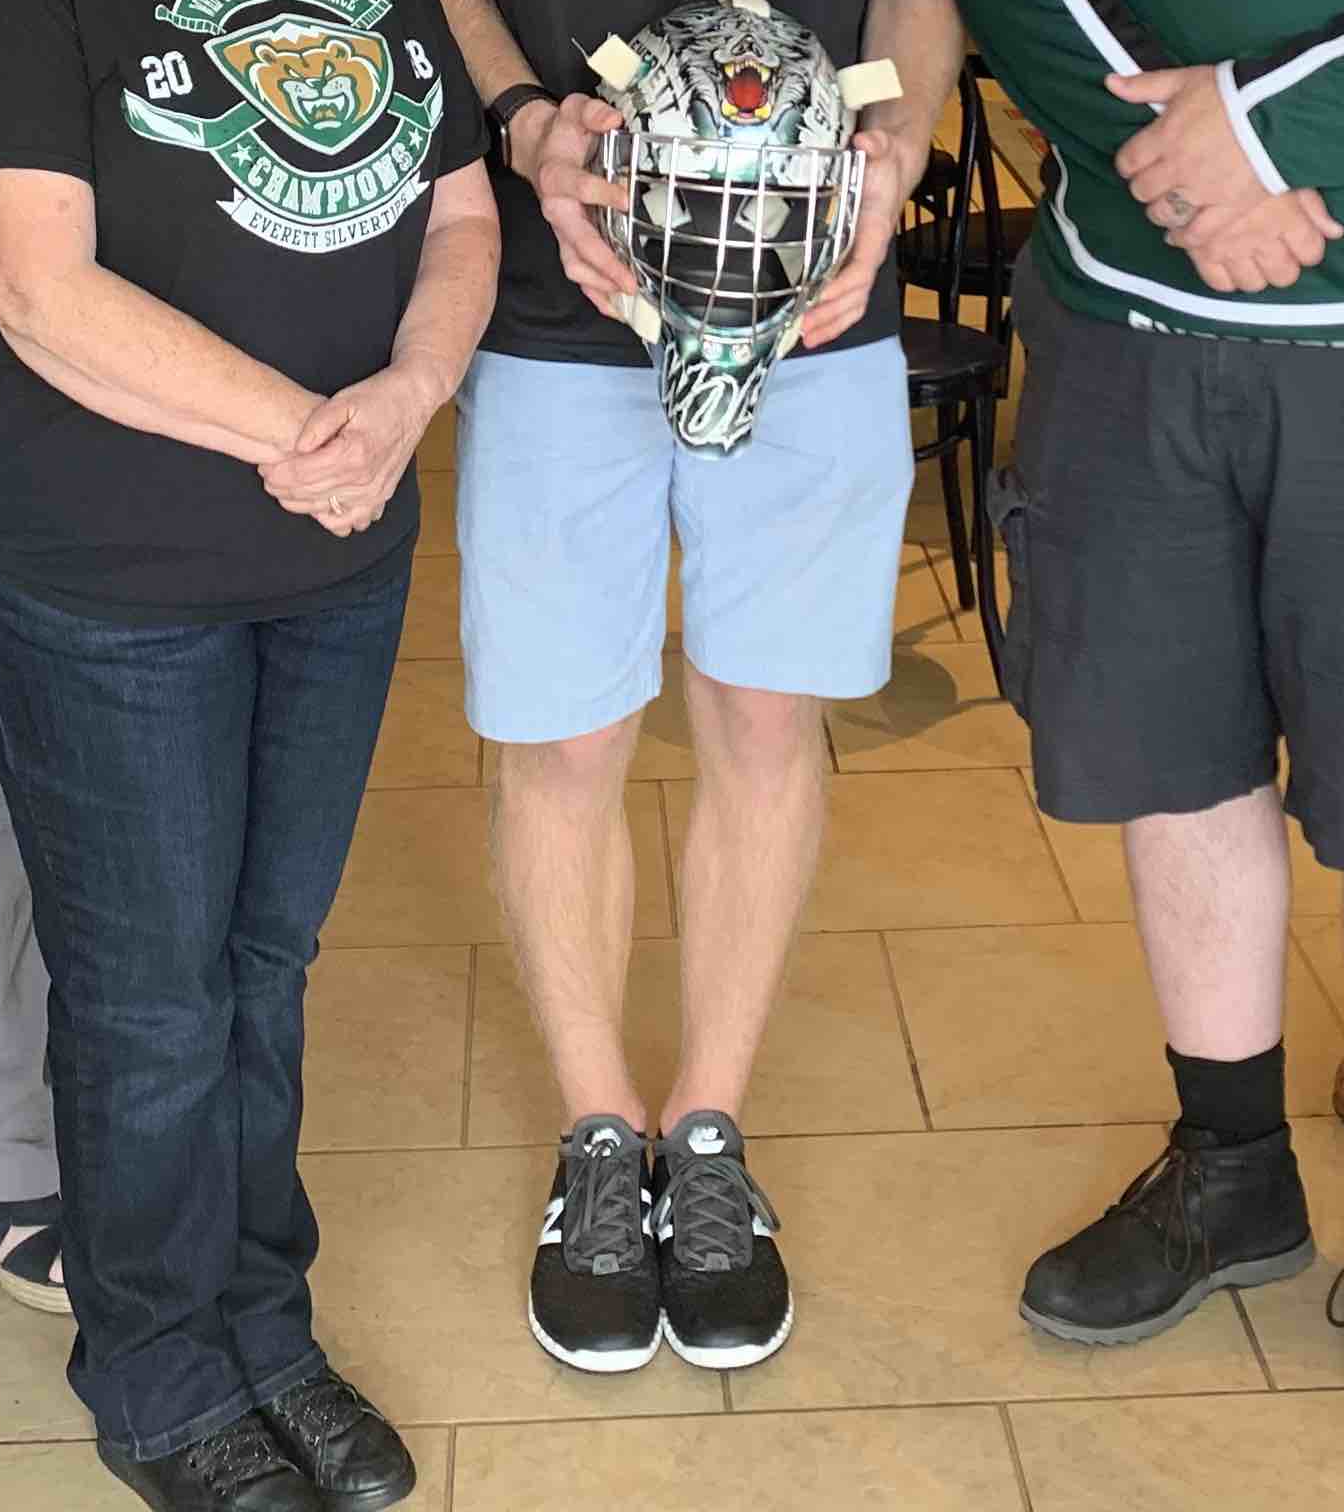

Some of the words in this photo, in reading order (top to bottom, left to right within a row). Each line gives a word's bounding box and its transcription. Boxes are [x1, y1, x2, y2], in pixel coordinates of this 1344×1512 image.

[247, 142, 413, 215] CHAMPIONS
[248, 213, 319, 249] EVERETT
[325, 193, 408, 247] SILVERTIPS
